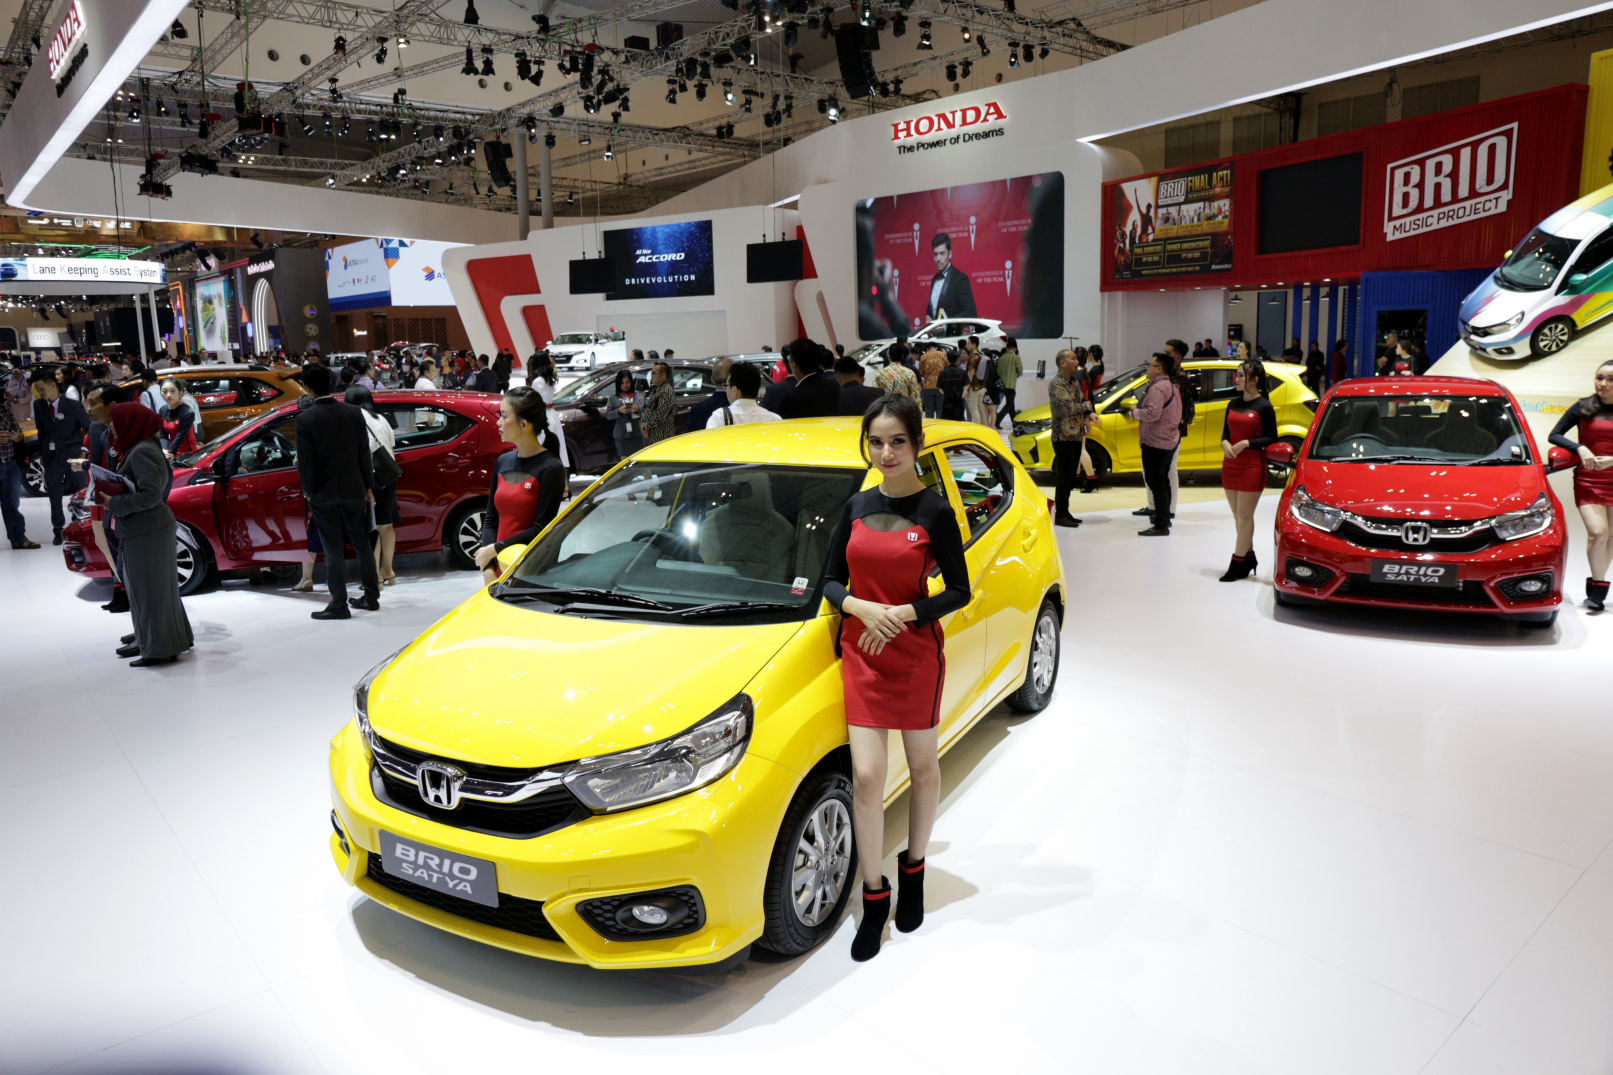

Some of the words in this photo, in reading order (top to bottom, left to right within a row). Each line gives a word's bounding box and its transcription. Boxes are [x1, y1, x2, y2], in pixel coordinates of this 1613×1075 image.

[891, 101, 1007, 141] HONDA
[897, 145, 915, 155] The
[917, 138, 948, 152] Power
[949, 134, 961, 146] of
[963, 127, 1005, 143] Dreams
[1187, 173, 1210, 192] FINAL
[1211, 169, 1231, 188] ACT!
[1391, 135, 1508, 218] BRIO
[1160, 180, 1185, 199] BRIO
[1392, 215, 1434, 237] MUSIC
[1436, 195, 1502, 225] PROJECT
[635, 252, 686, 264] ACCORD
[32, 264, 56, 275] Lane
[59, 264, 99, 278] Keeping
[102, 264, 132, 276] Assist
[134, 266, 158, 279] System
[625, 274, 696, 285] DRIVEVOLUTION
[1381, 563, 1446, 576] BRIO
[1384, 573, 1440, 584] SATYA
[394, 842, 478, 881] BRIO
[400, 862, 473, 895] SATYA
